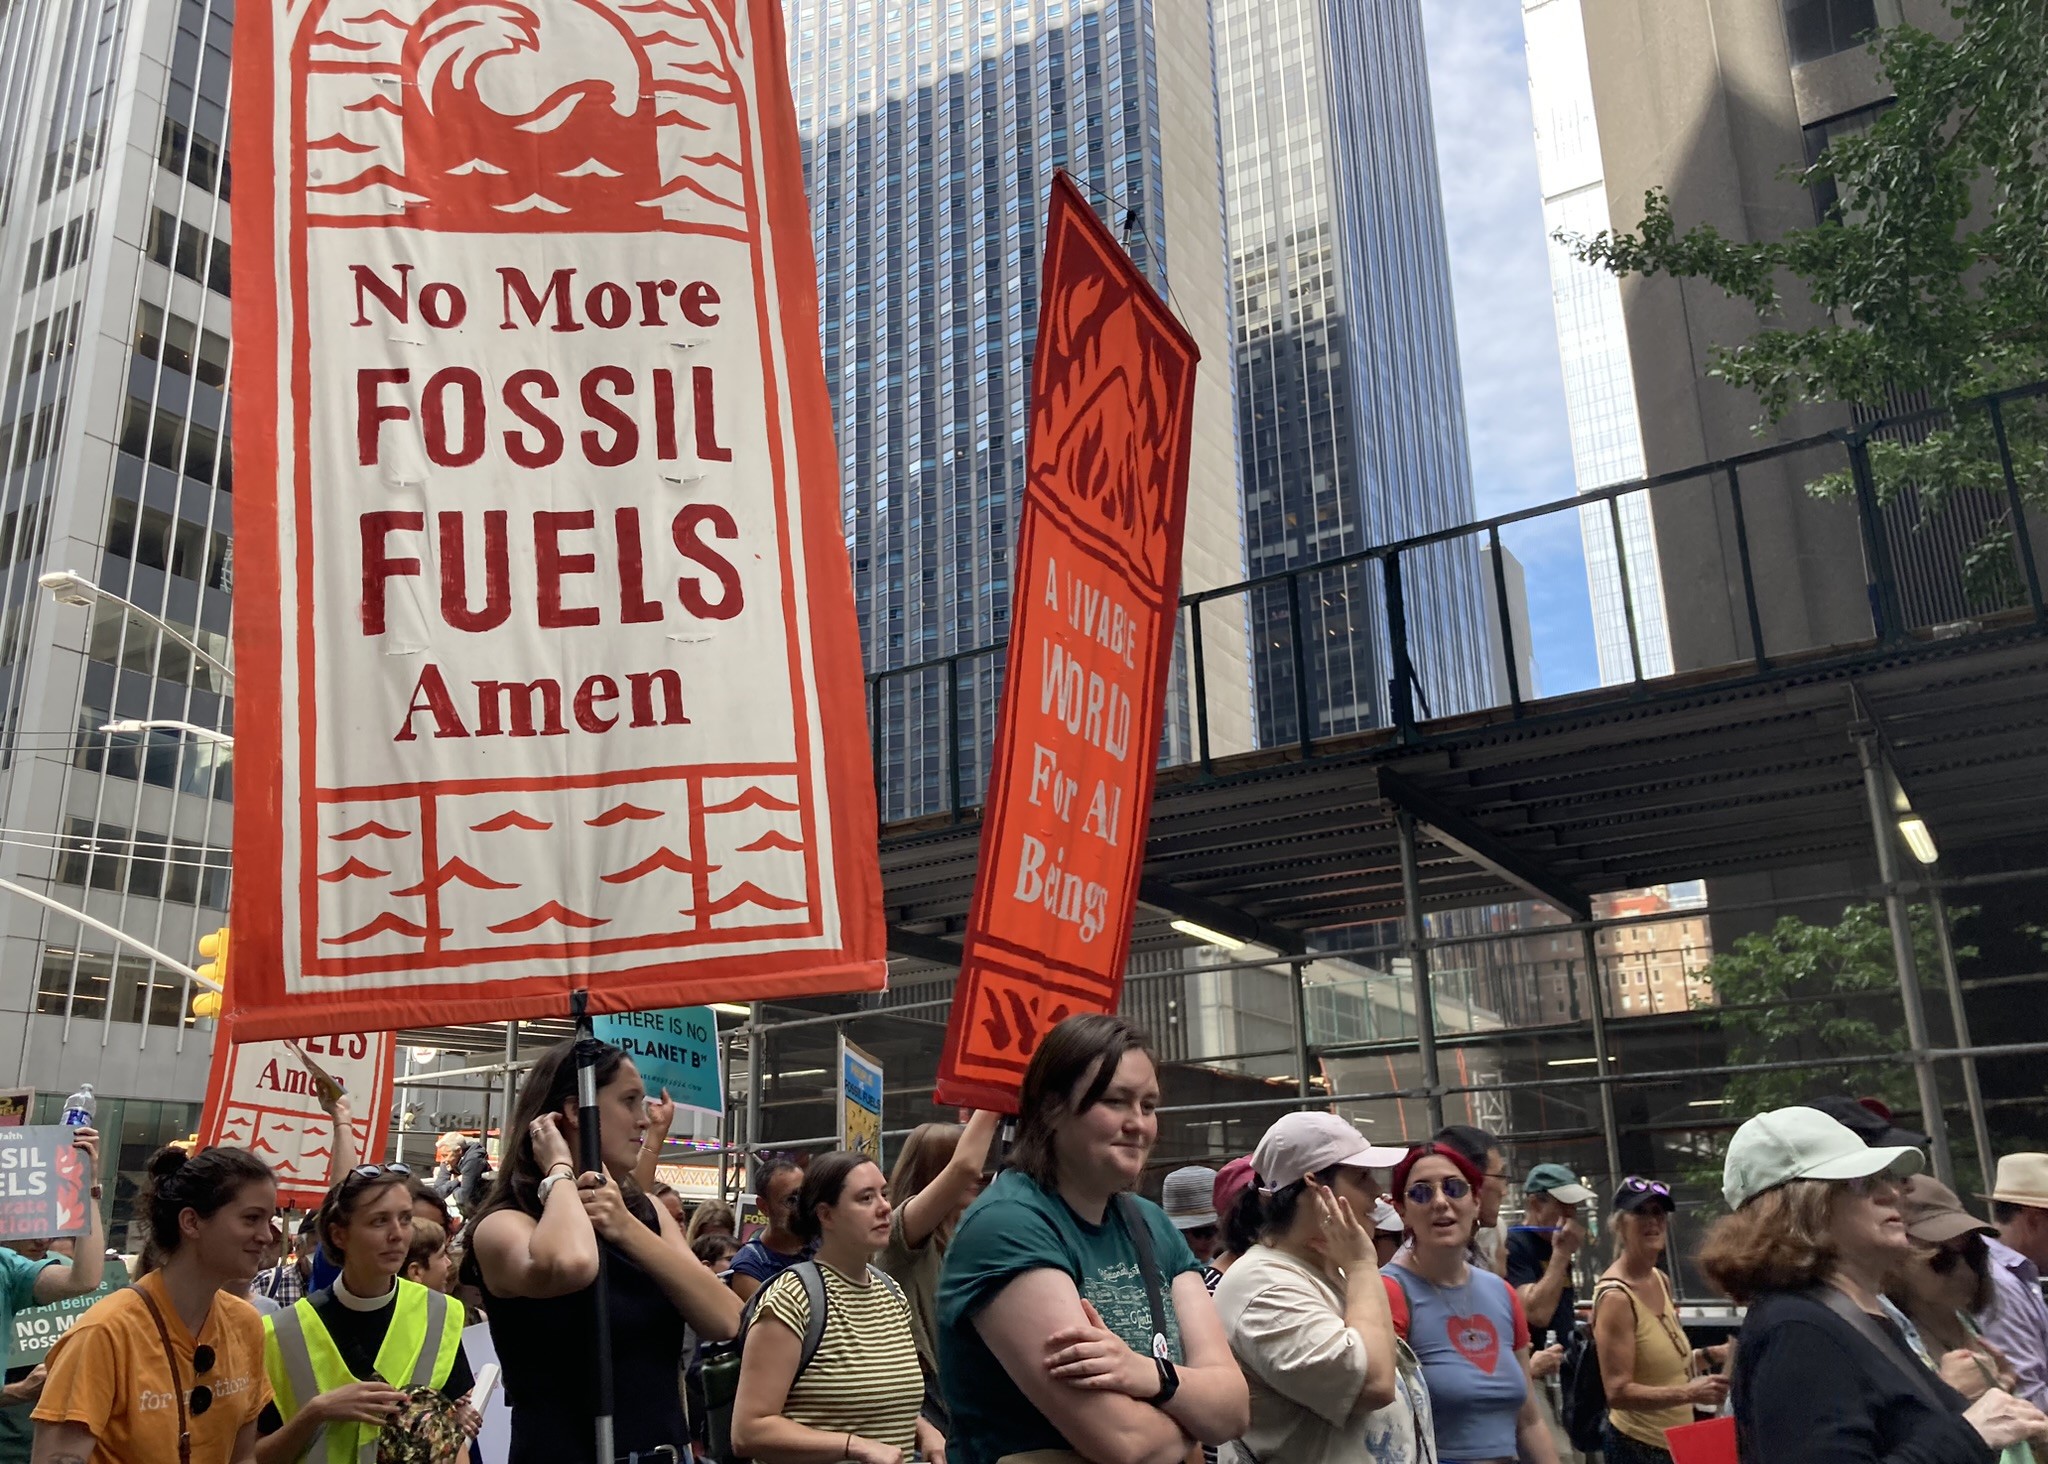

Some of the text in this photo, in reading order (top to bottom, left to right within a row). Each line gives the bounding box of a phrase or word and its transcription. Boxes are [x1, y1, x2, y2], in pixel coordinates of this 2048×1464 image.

[349, 264, 721, 332] No More
[356, 365, 733, 468] FOSSIL
[359, 503, 745, 636] FUELS
[1045, 557, 1058, 612] A
[393, 663, 692, 742] Amen
[1041, 637, 1131, 762] WORLD
[1028, 742, 1079, 824] For
[1013, 833, 1109, 943] Beings
[669, 1017, 682, 1035] IS
[687, 1022, 707, 1042] NO
[16, 1319, 50, 1337] NO
